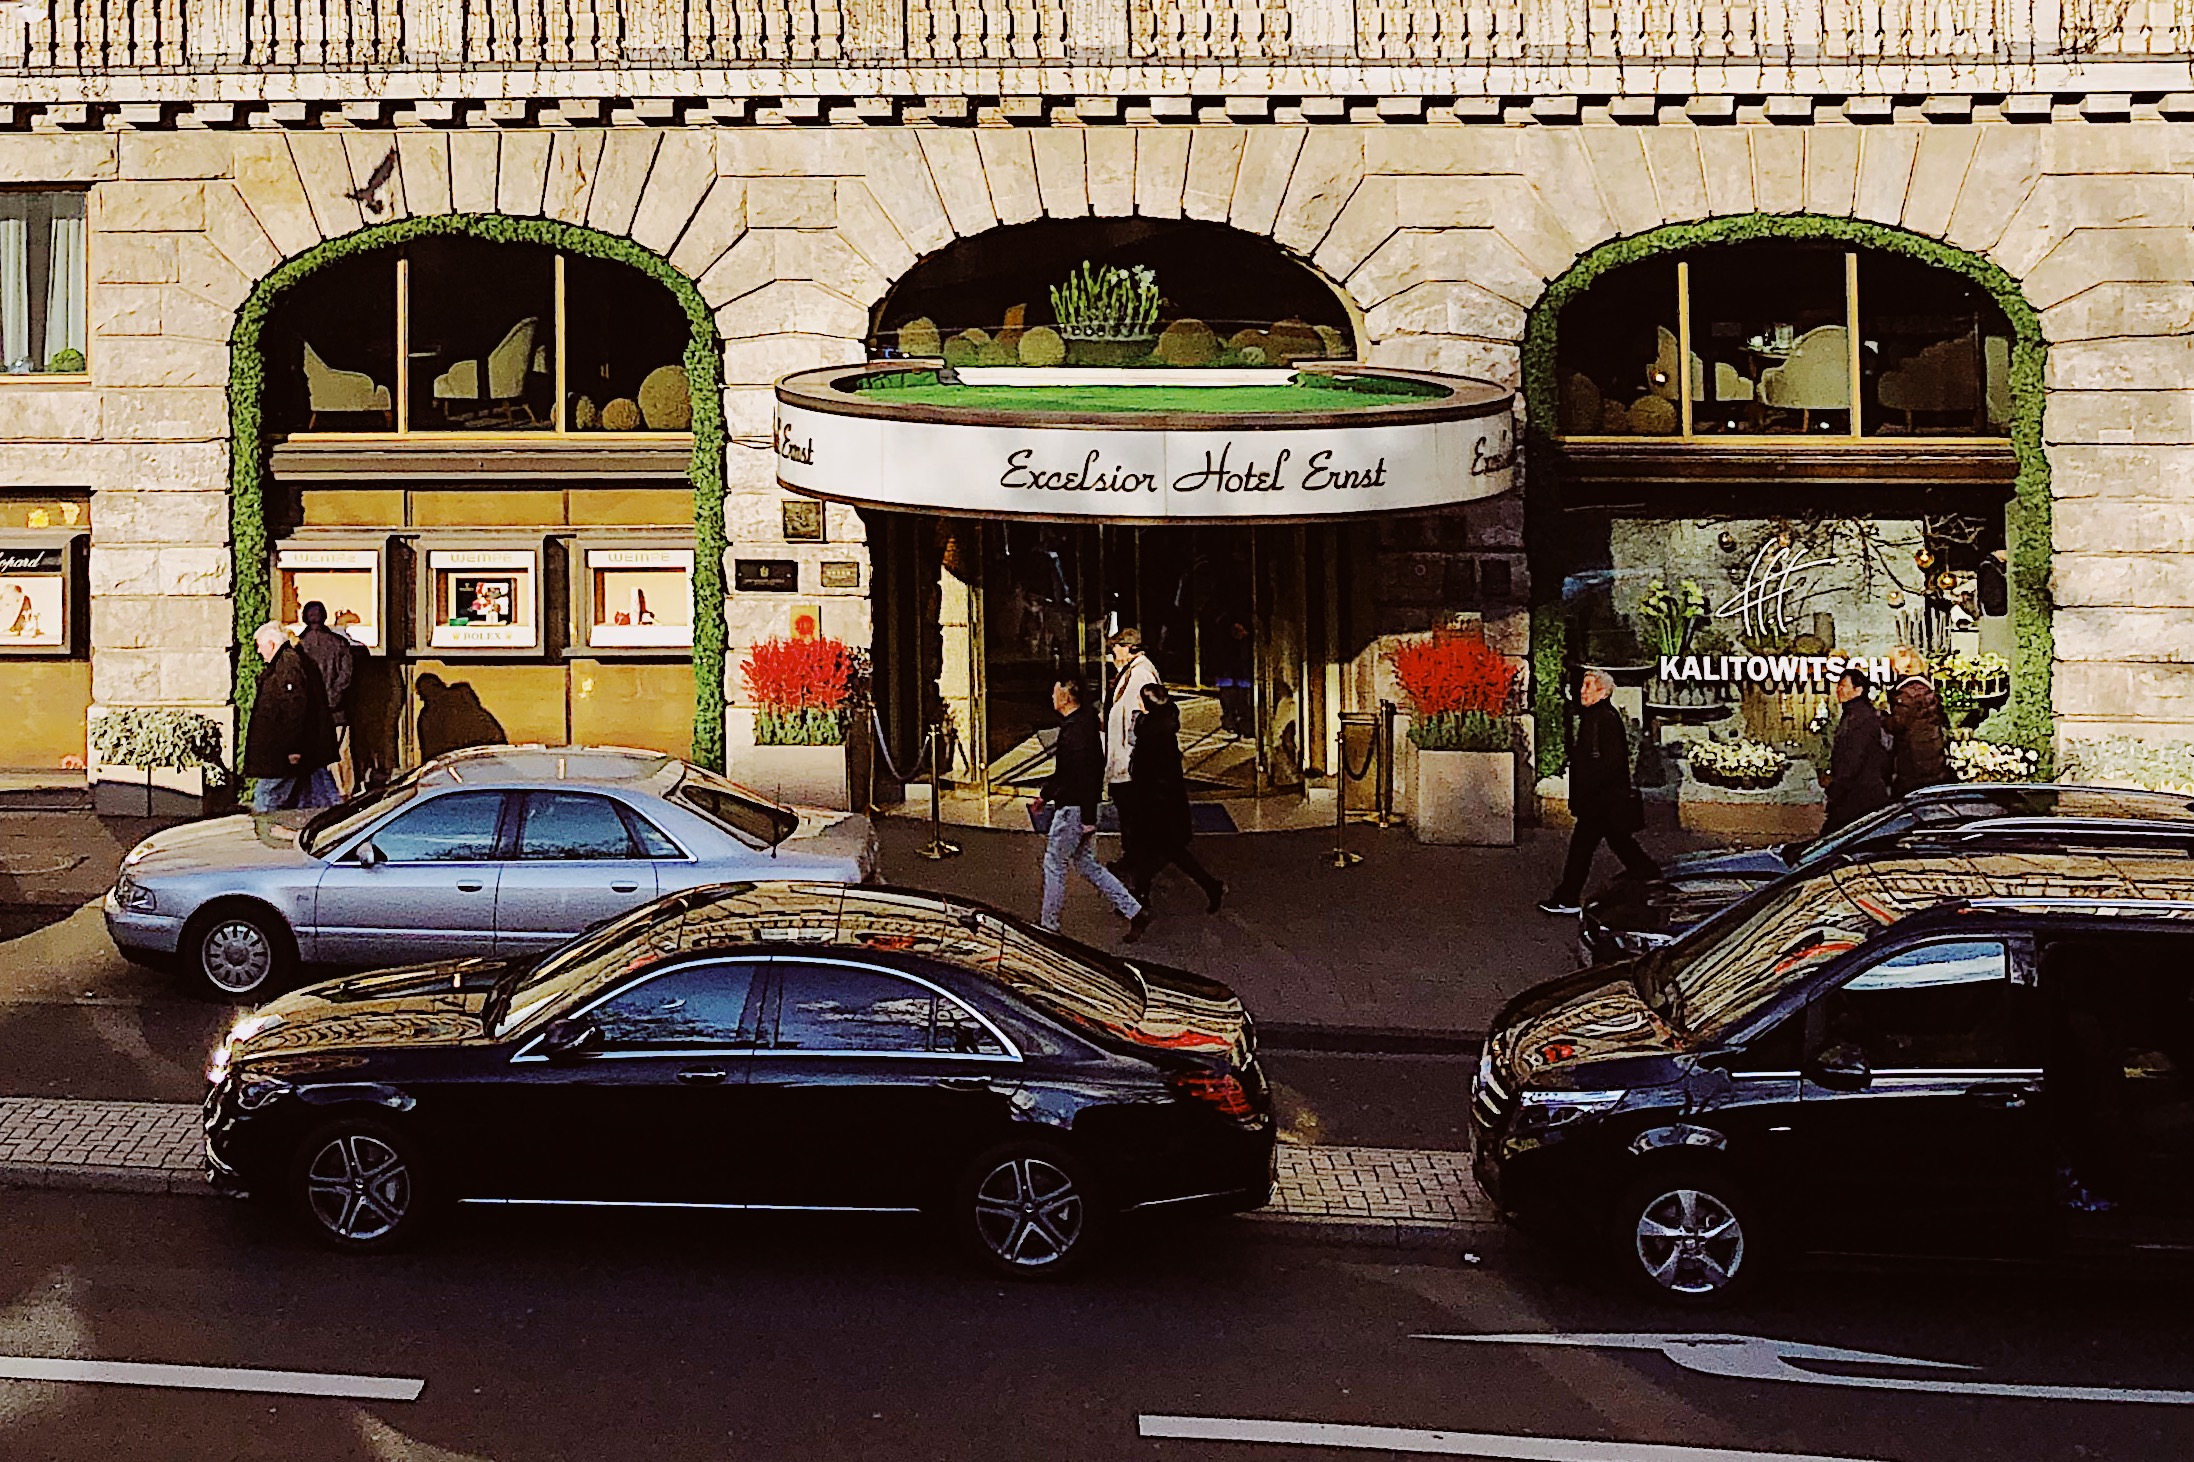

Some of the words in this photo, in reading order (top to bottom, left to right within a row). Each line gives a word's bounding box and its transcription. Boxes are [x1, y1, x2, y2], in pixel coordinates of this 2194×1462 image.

[1000, 448, 1158, 493] Excelsior
[1172, 441, 1291, 493] Hotel
[1301, 449, 1387, 492] Ernst
[0, 550, 45, 573] opard
[450, 553, 513, 563] WEMPE
[608, 552, 670, 563] WEMPE
[463, 632, 501, 641] ROLEX
